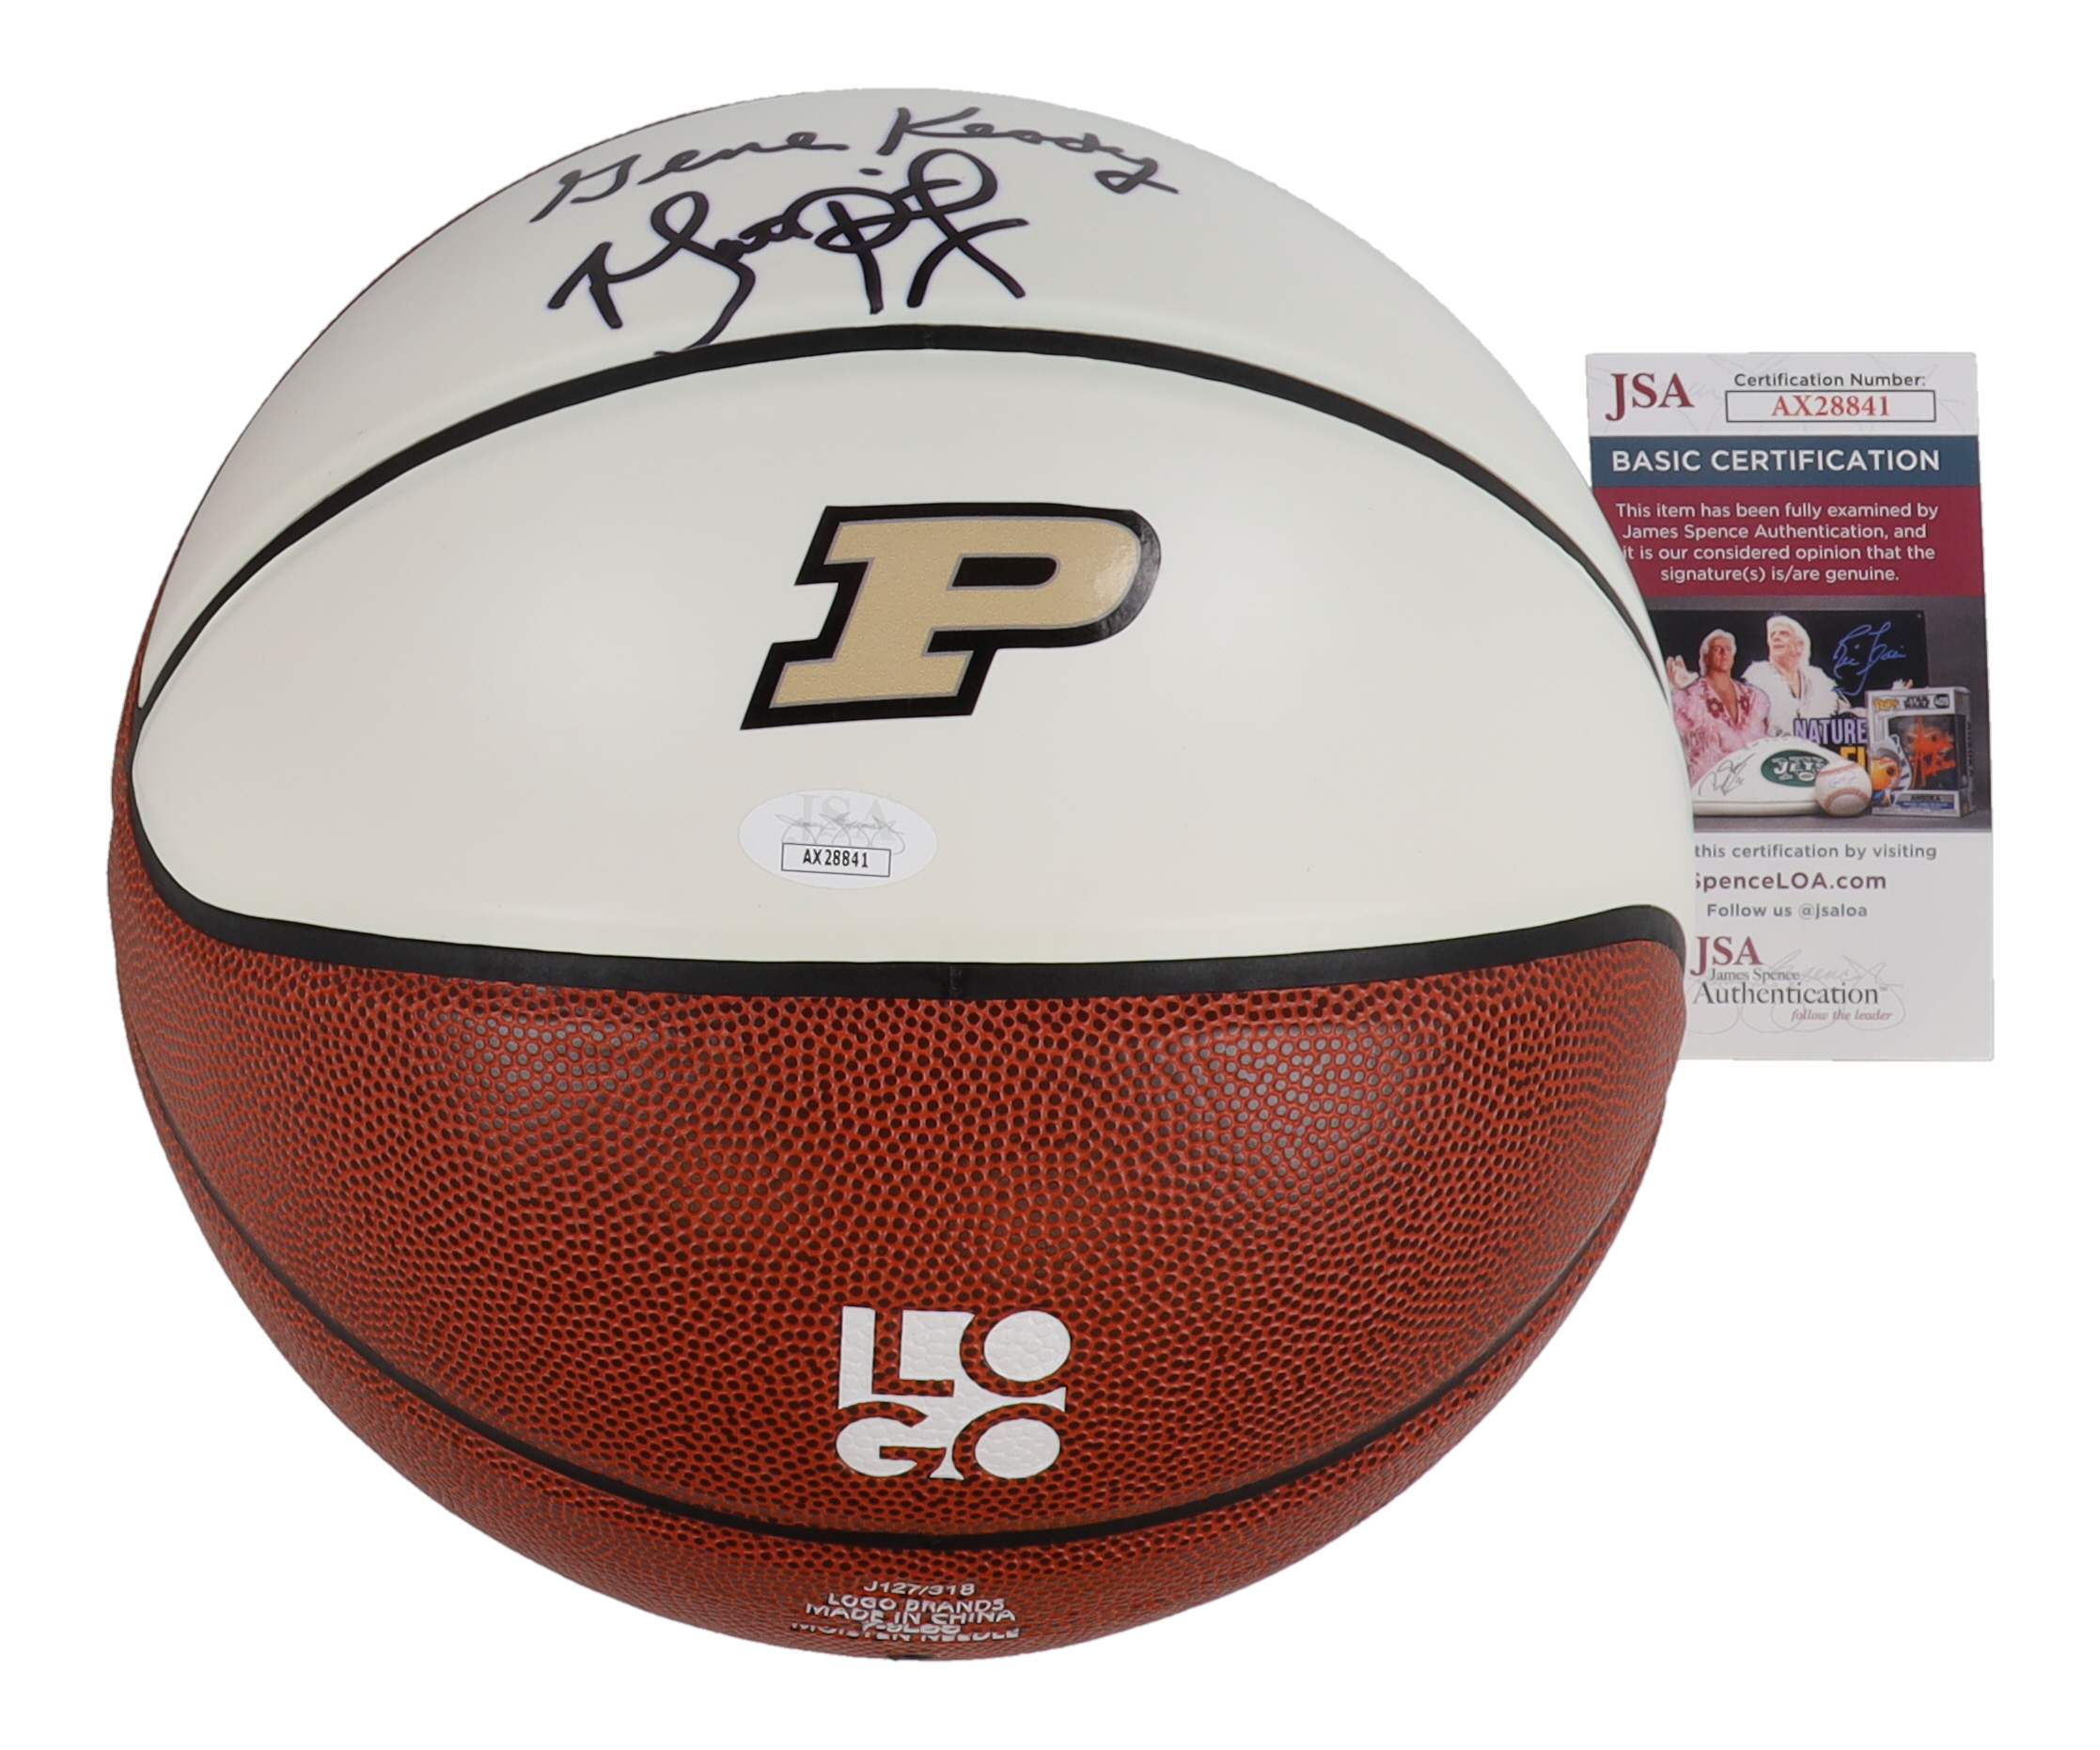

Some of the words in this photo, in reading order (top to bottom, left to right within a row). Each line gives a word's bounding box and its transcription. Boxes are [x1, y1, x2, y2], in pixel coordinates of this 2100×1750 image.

[528, 131, 850, 222] Gene
[1733, 373, 1844, 388] Certification
[1849, 373, 1927, 388] Number:
[1606, 373, 1694, 421] JSA
[1771, 395, 1890, 417] AX28841
[1613, 450, 1700, 471] BASIC
[1711, 449, 1939, 471] CERTIFICATION
[1616, 503, 1651, 517] This
[1657, 503, 1695, 517] item
[1701, 503, 1731, 517] has
[1736, 503, 1779, 517] been
[1785, 503, 1822, 520] fully
[1827, 503, 1911, 517] examined
[1918, 503, 1938, 520] by
[1622, 524, 1678, 539] James
[1685, 524, 1748, 540] Spence
[1754, 523, 1888, 539] Authentication,
[1894, 523, 1926, 538] and
[1623, 545, 1635, 561] it
[1640, 545, 1653, 559] is
[1659, 549, 1688, 559] our
[1694, 545, 1790, 559] considered
[1794, 544, 1861, 562] opinion
[1867, 545, 1902, 559] that
[1907, 545, 1935, 559] the
[1661, 566, 1765, 583] signature(s)
[1772, 565, 1820, 583] is/are
[1826, 566, 1899, 583] genuine.
[740, 502, 1162, 730] P
[1794, 717, 1868, 744] NATURE
[802, 848, 870, 868] AX28841
[1695, 844, 1725, 857] this
[1732, 844, 1838, 857] certification
[1845, 844, 1866, 860] by
[1873, 844, 1936, 860] visiting
[1707, 903, 1766, 916] Follow
[1774, 907, 1792, 916] us
[1798, 903, 1867, 919] @jsaloa
[1690, 936, 1763, 976] JSA
[1709, 968, 1749, 981] James
[1753, 968, 1800, 984] Spence
[1692, 982, 1878, 1005] Authentication
[1791, 1009, 1828, 1023] follow
[1833, 1009, 1851, 1021] the
[1855, 1009, 1893, 1021] leader
[863, 1580, 975, 1596] J127/318
[827, 1592, 897, 1610] LOGO
[905, 1599, 1005, 1613] BRANDS
[806, 1602, 885, 1622] MADE
[894, 1611, 921, 1625] IN
[931, 1609, 1015, 1624] CHINA
